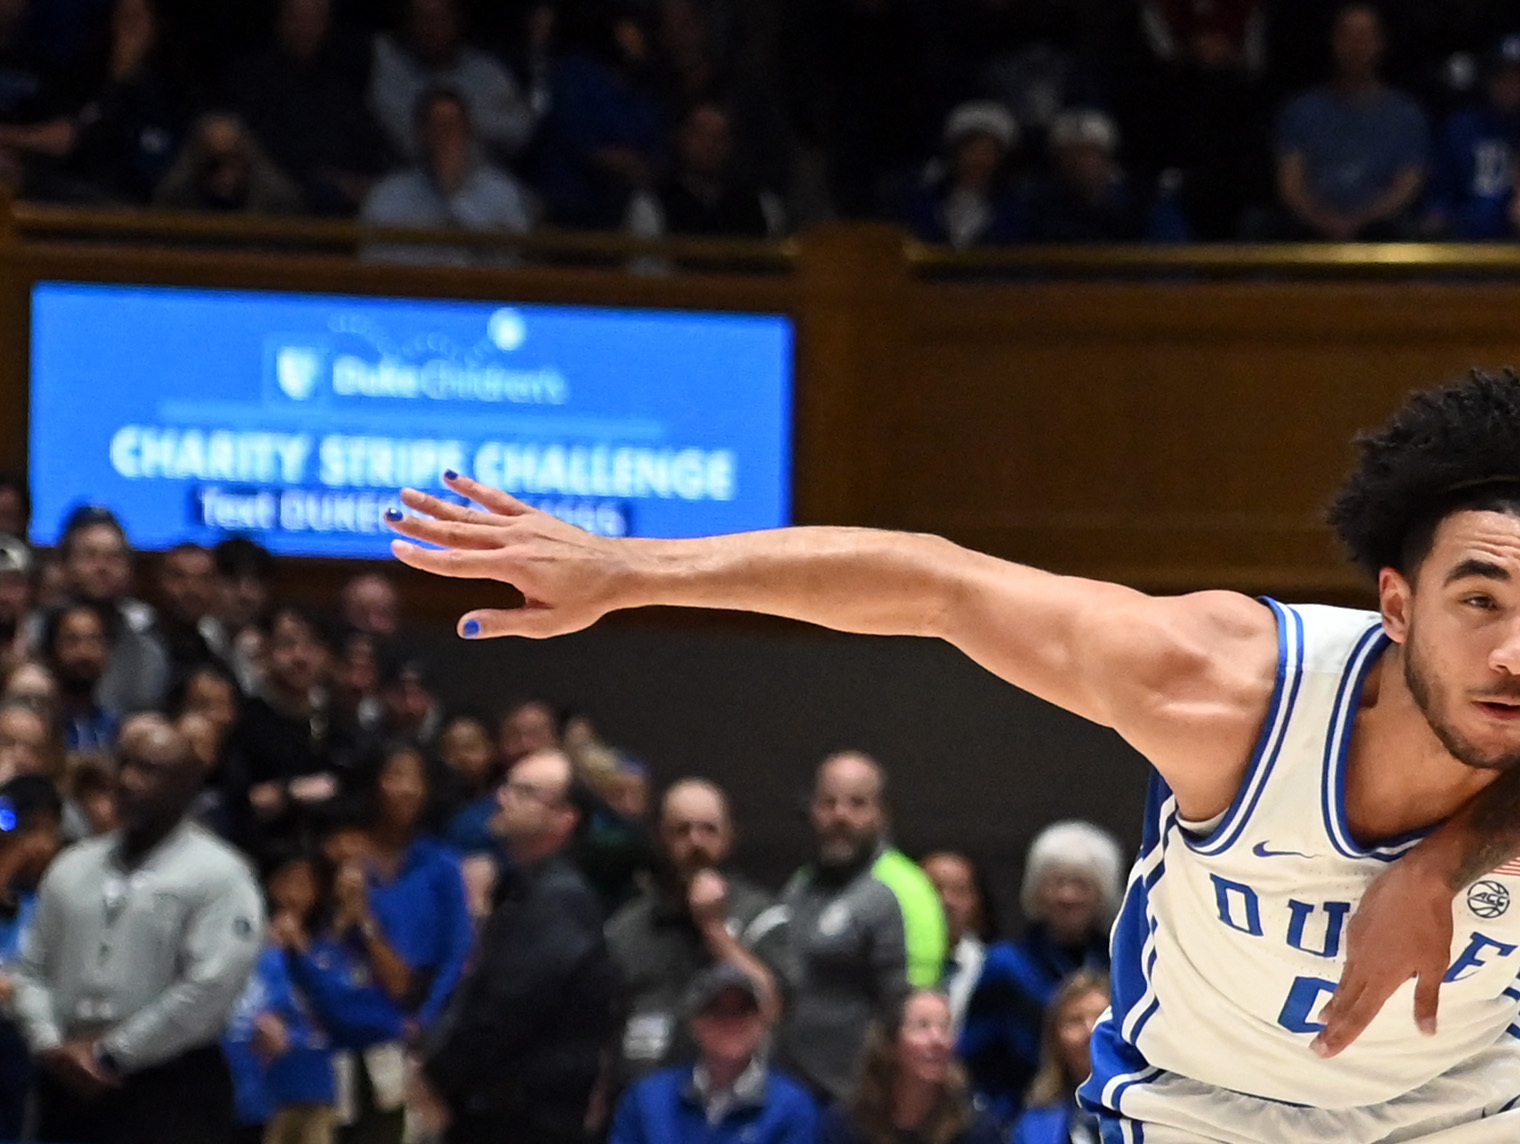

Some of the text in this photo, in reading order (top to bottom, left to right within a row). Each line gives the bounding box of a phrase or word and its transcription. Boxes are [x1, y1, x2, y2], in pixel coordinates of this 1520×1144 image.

[110, 425, 311, 484] CHARITY
[473, 441, 736, 501] CHALLENGE
[1209, 872, 1519, 984] DUE
